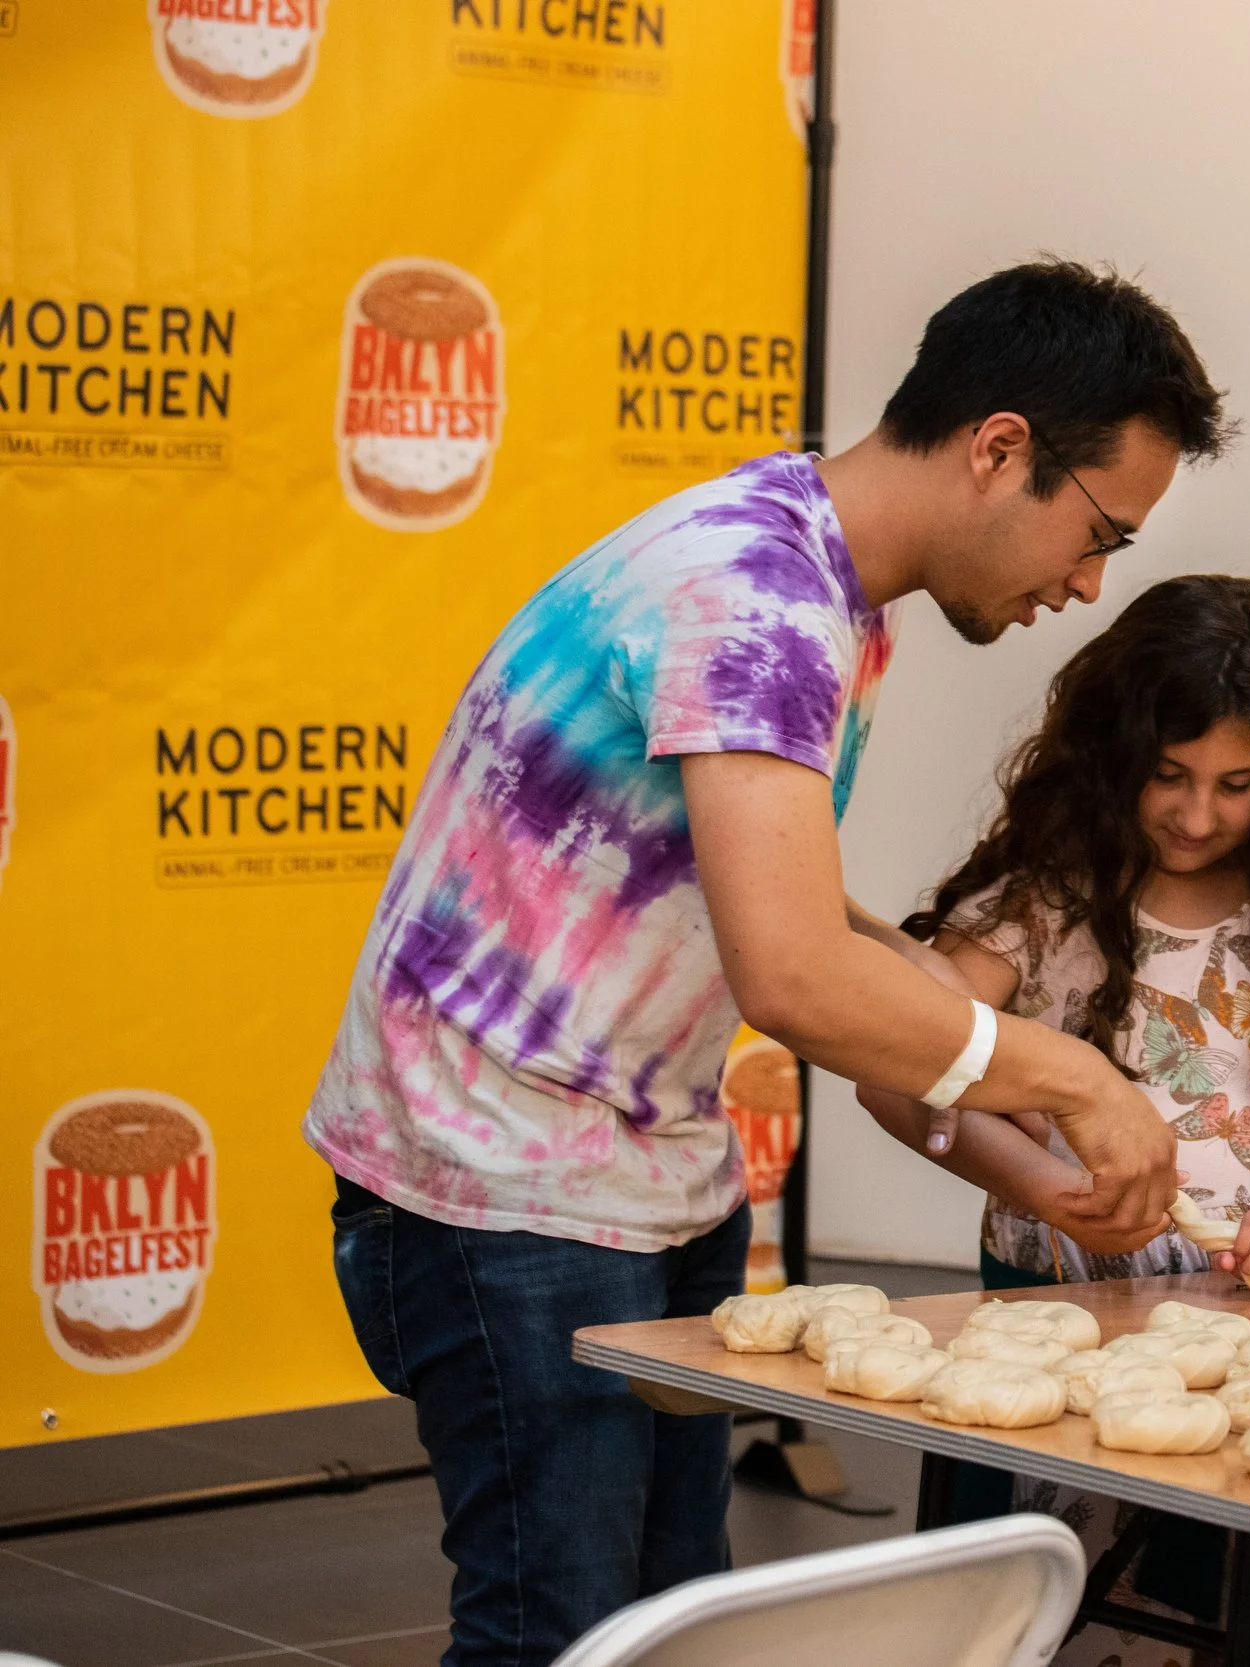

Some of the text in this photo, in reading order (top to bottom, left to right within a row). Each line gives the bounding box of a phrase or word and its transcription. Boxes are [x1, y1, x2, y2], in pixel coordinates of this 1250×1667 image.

[451, 0, 666, 48] KITCHEN
[350, 323, 496, 394] BKLYN
[618, 327, 796, 380] MODER
[344, 397, 497, 441] BAGELFEST
[617, 385, 795, 435] KITCHE
[155, 723, 407, 776] MODERN
[156, 784, 406, 838] KITCHEN
[44, 1154, 208, 1238] BKLYN
[43, 1228, 211, 1284] BAGELFEST
